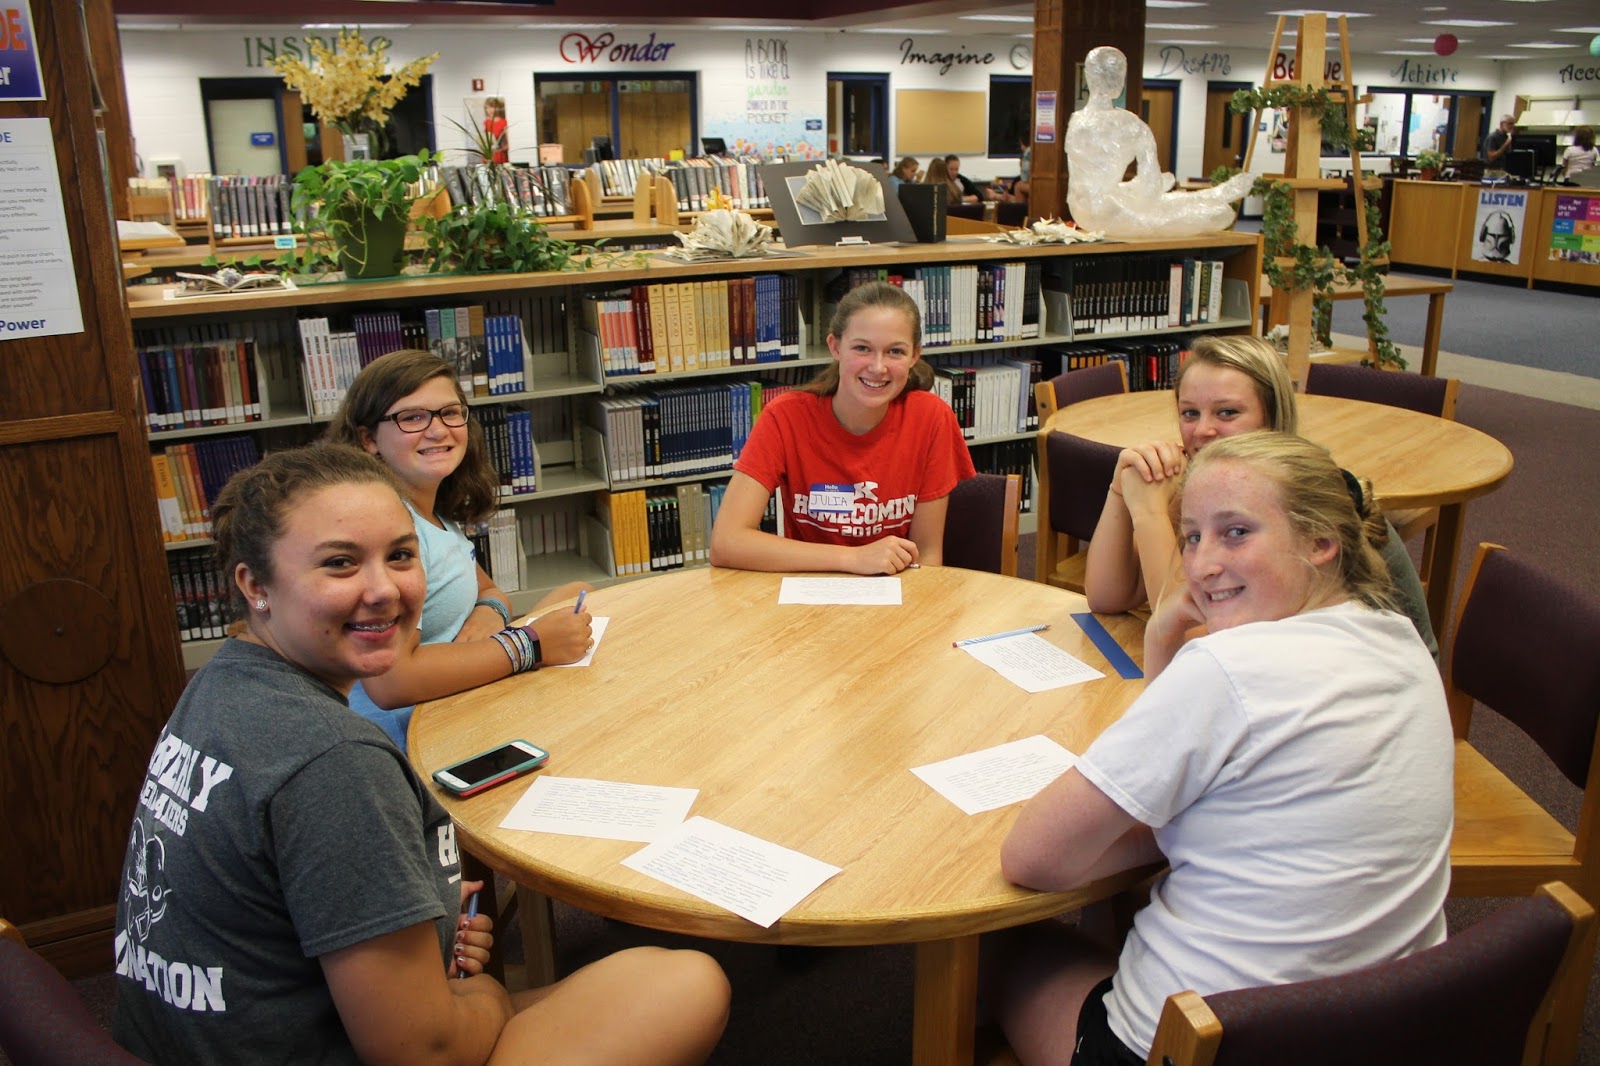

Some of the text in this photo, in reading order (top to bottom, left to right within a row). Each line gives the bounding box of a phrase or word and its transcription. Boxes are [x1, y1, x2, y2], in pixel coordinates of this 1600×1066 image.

[560, 32, 675, 63] Wonder
[900, 38, 995, 76] Imagine
[1391, 59, 1460, 85] Achieve
[1481, 192, 1525, 207] LISTEN
[811, 493, 848, 506] JULIA
[853, 481, 878, 502] K
[841, 524, 883, 538] 2016
